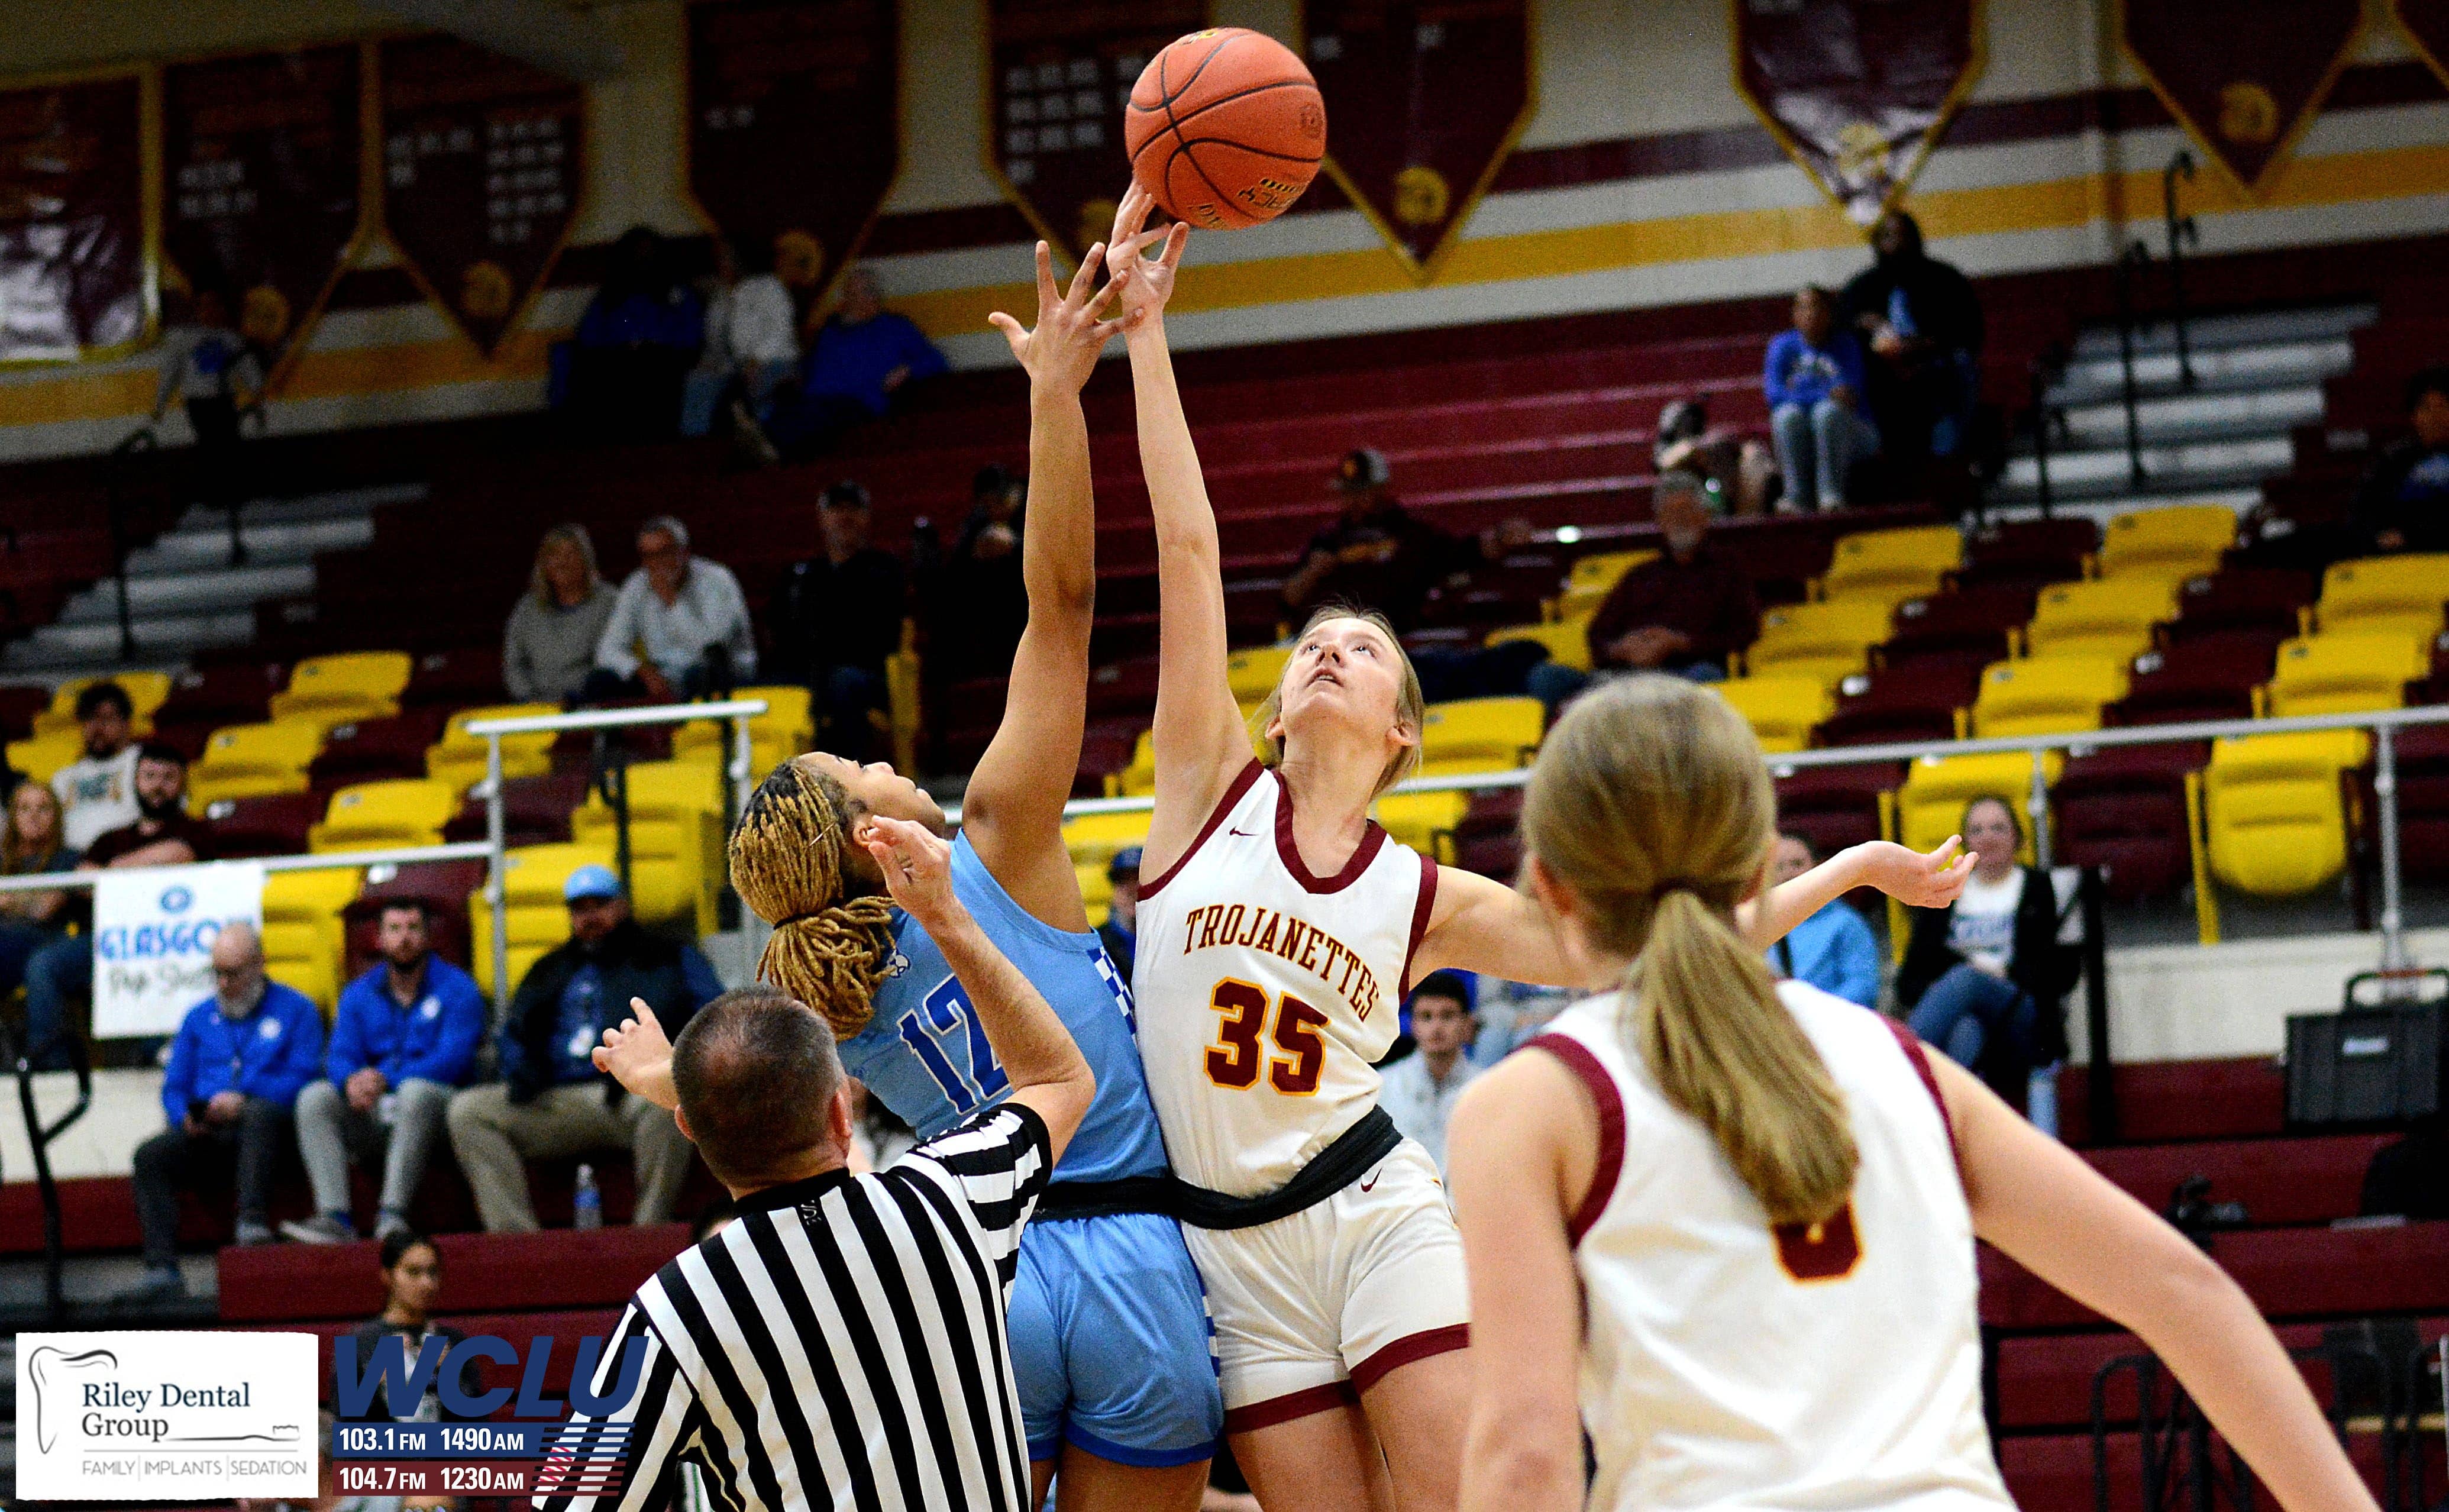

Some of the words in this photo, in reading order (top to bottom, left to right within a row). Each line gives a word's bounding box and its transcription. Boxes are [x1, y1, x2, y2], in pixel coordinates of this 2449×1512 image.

[100, 918, 253, 961] GLASGO
[1184, 903, 1379, 1023] TROJANETTES
[896, 973, 1012, 1115] 12
[1203, 976, 1330, 1096] 35
